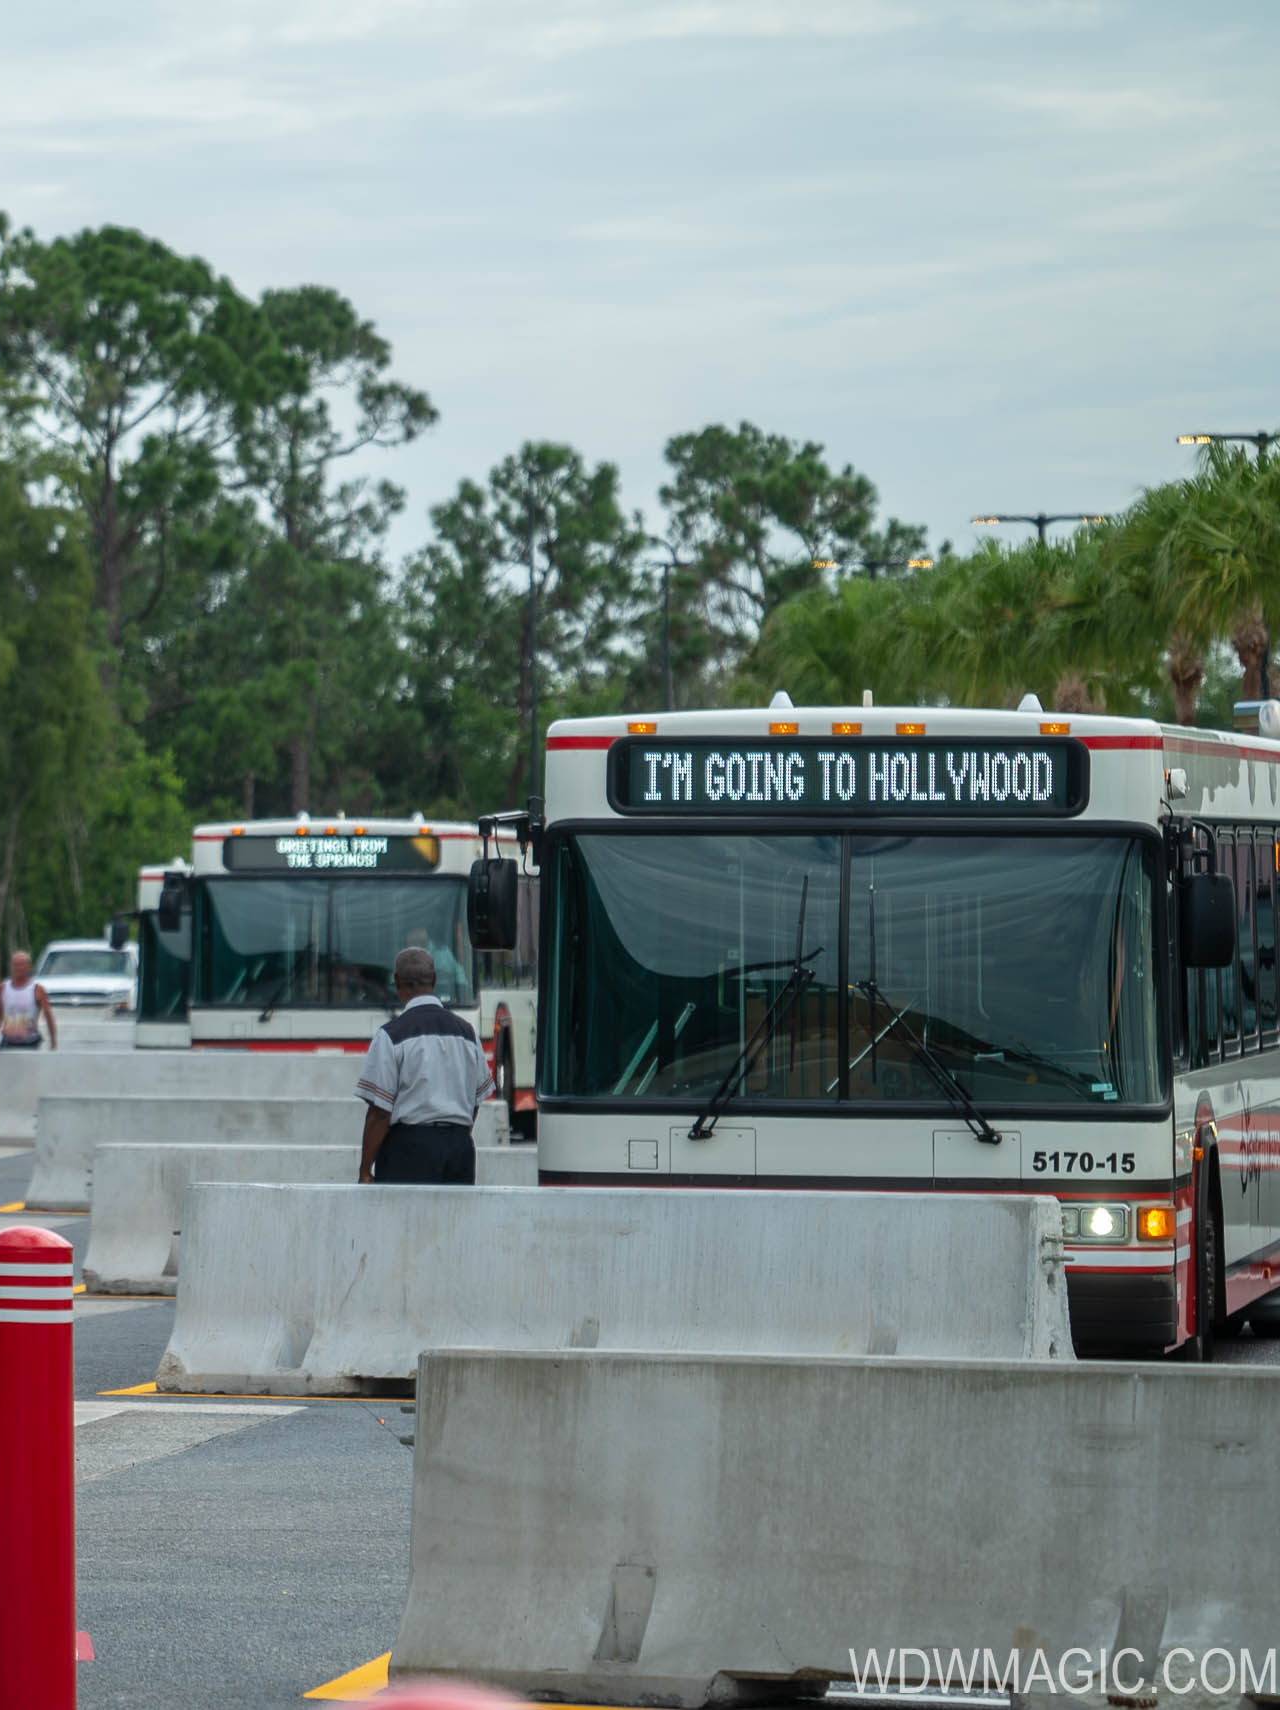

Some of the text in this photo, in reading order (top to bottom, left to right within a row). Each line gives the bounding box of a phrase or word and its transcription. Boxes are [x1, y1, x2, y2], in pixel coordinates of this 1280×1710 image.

[643, 752, 1053, 801] I'M GOING TO HOLLYWOOD
[1032, 1151, 1136, 1174] 5170-15
